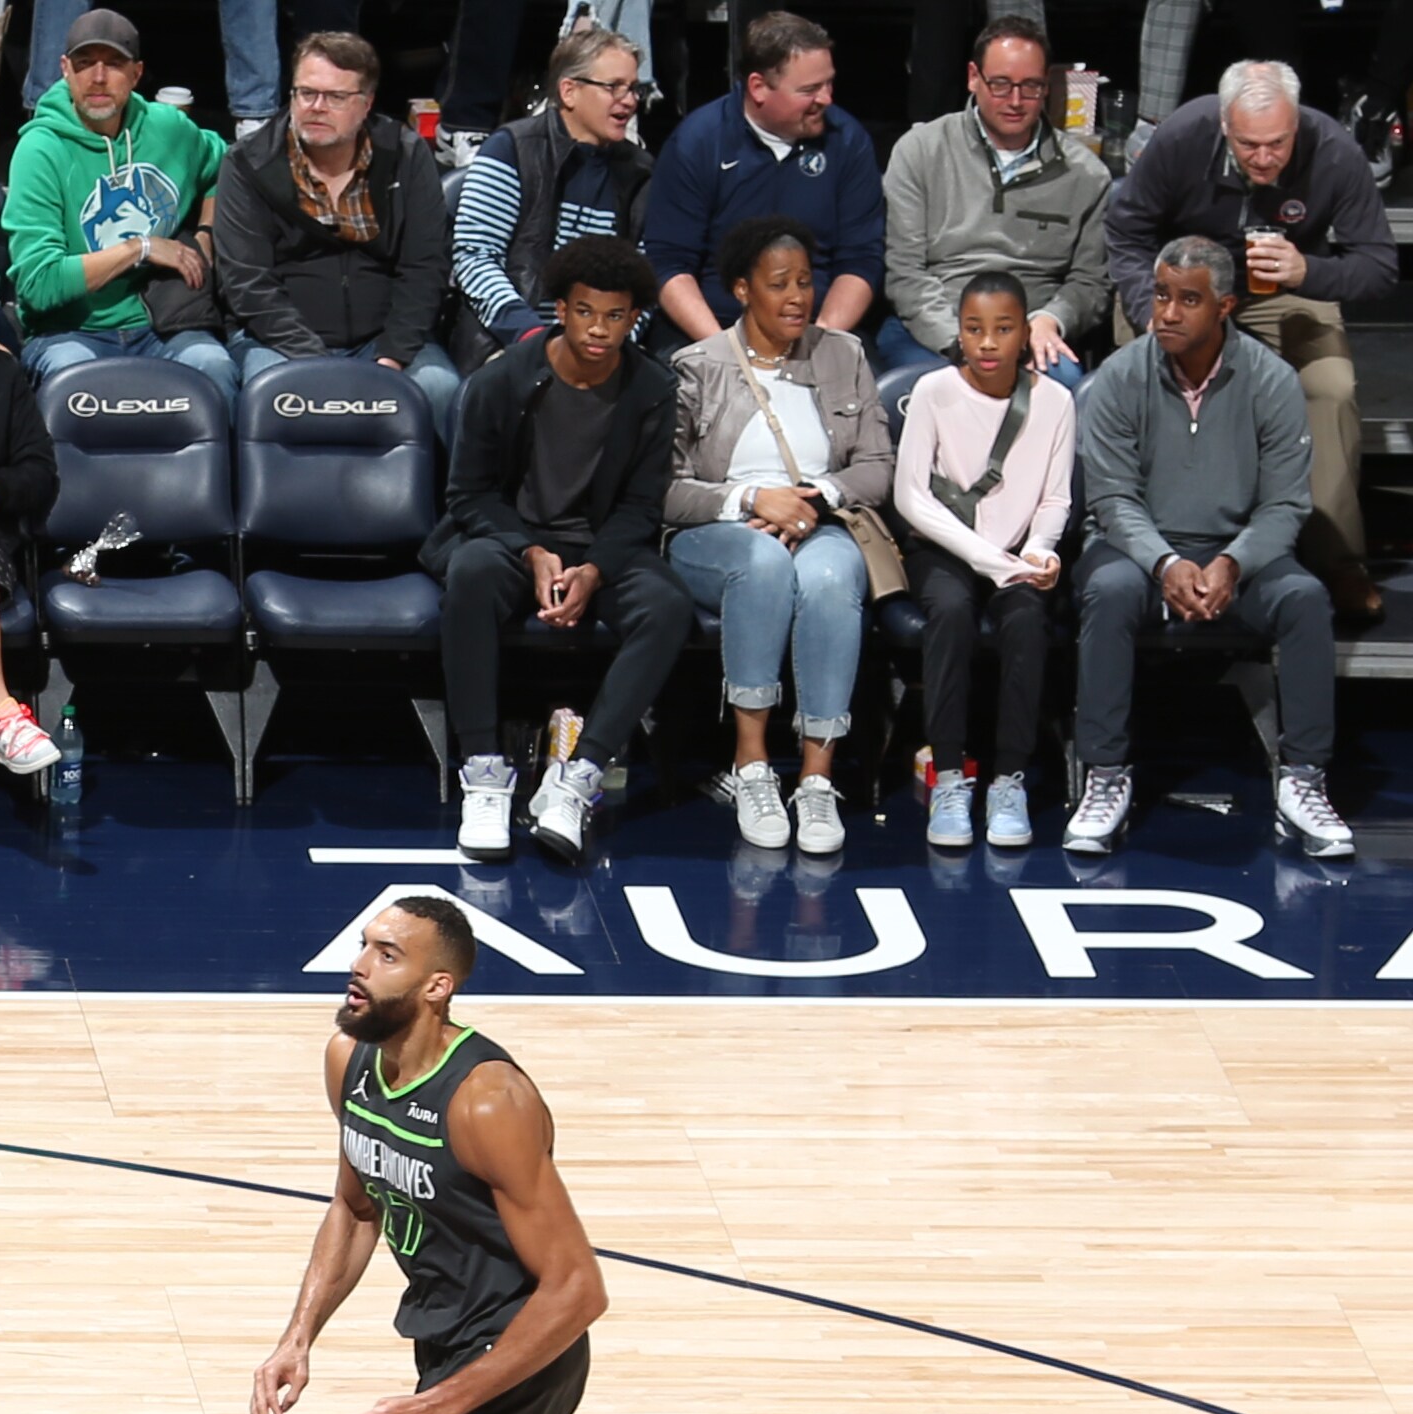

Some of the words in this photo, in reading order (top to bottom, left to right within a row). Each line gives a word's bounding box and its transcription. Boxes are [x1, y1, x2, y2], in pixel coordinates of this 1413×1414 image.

[101, 397, 190, 414] LEXUS
[307, 399, 398, 415] LEXUS
[343, 1124, 436, 1201] TIMBERWOLVES
